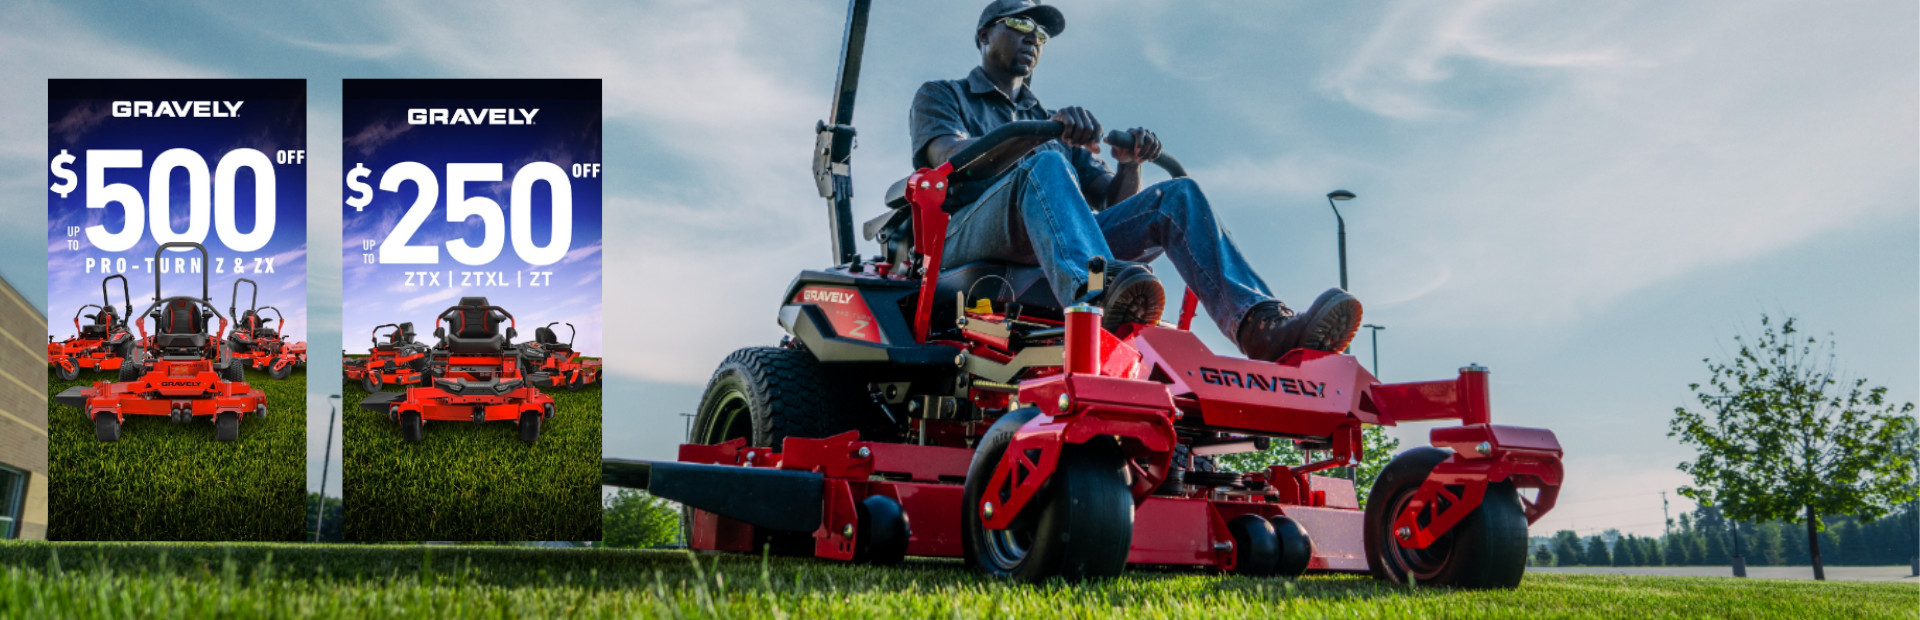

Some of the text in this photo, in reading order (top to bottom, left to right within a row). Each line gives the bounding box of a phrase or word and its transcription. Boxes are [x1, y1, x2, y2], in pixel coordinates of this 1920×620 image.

[803, 289, 854, 304] GRAVELY
[849, 319, 869, 338] Z
[1199, 366, 1326, 399] GRAVELY
